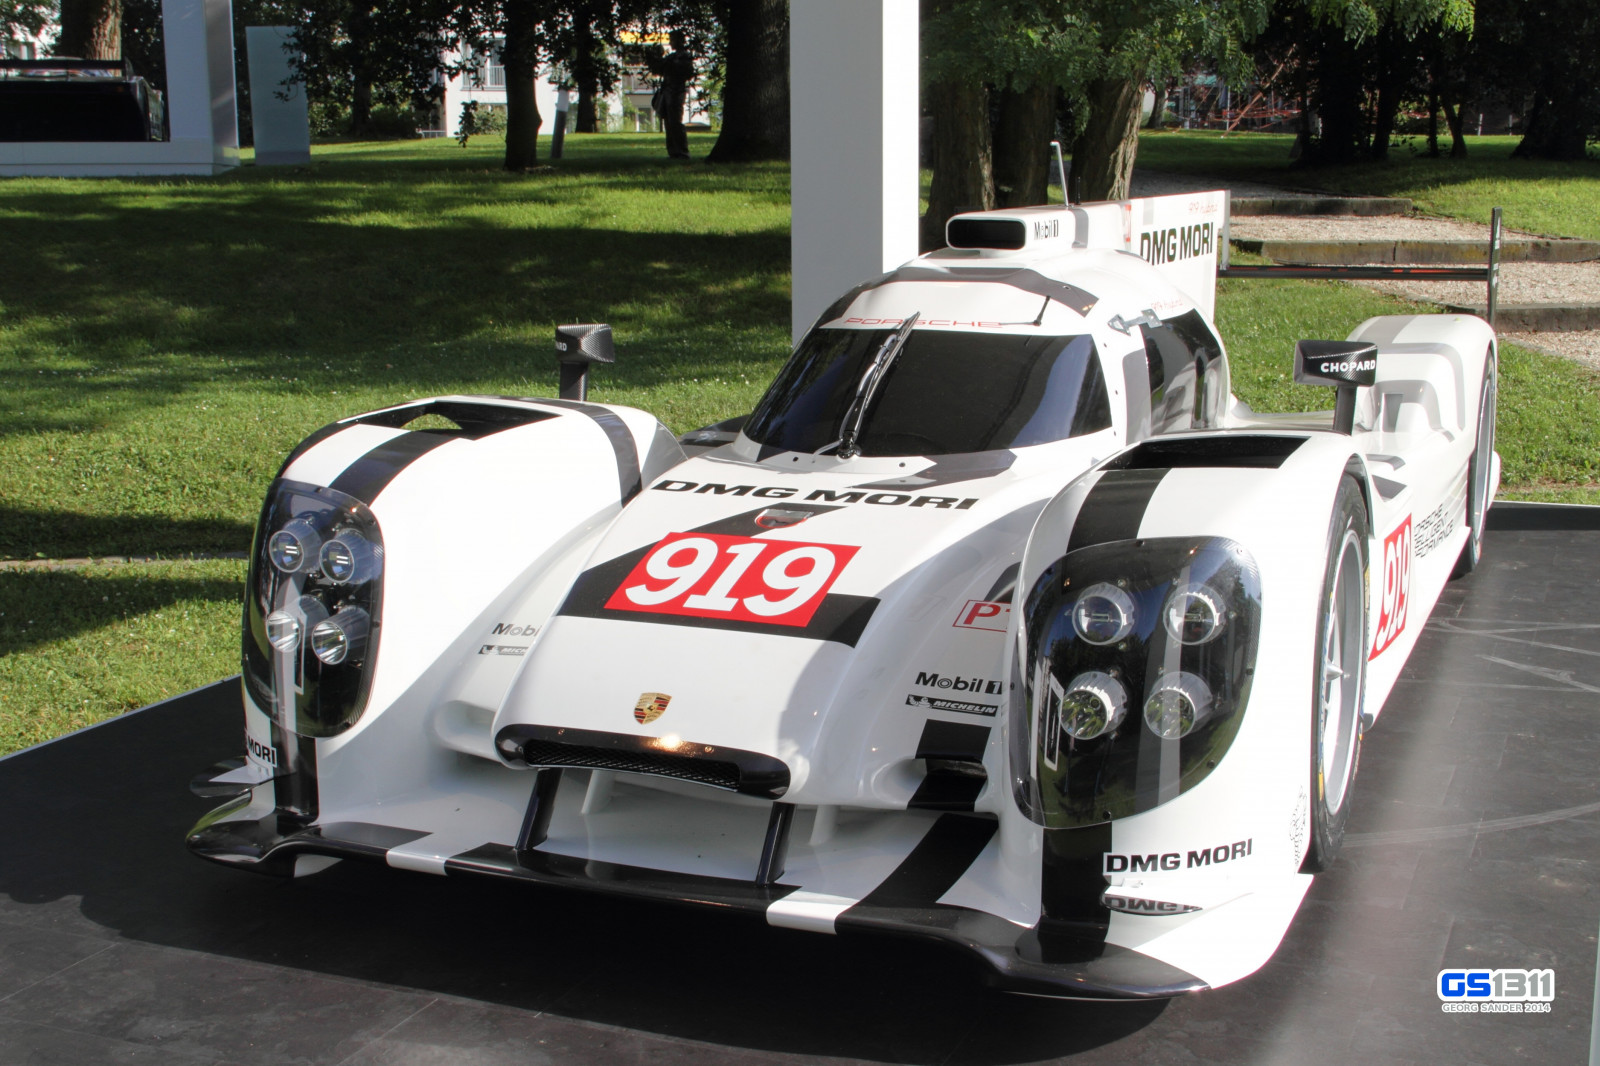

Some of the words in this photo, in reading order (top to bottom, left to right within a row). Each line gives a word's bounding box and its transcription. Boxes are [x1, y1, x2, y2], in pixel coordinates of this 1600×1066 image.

[1034, 219, 1052, 240] Mobil
[1140, 228, 1177, 266] DMG
[1180, 221, 1214, 260] MORI
[1320, 360, 1376, 373] CHOPARD
[650, 479, 799, 499] DMG
[803, 489, 980, 510] MORI
[625, 537, 836, 617] 919
[1375, 524, 1411, 651] 919
[963, 602, 1010, 626] P
[491, 622, 542, 637] Mobi
[915, 671, 984, 693] Mobil
[931, 699, 997, 714] MICHELIN
[247, 735, 276, 765] MORI
[1106, 853, 1181, 873] DMG
[1187, 838, 1253, 868] MORI
